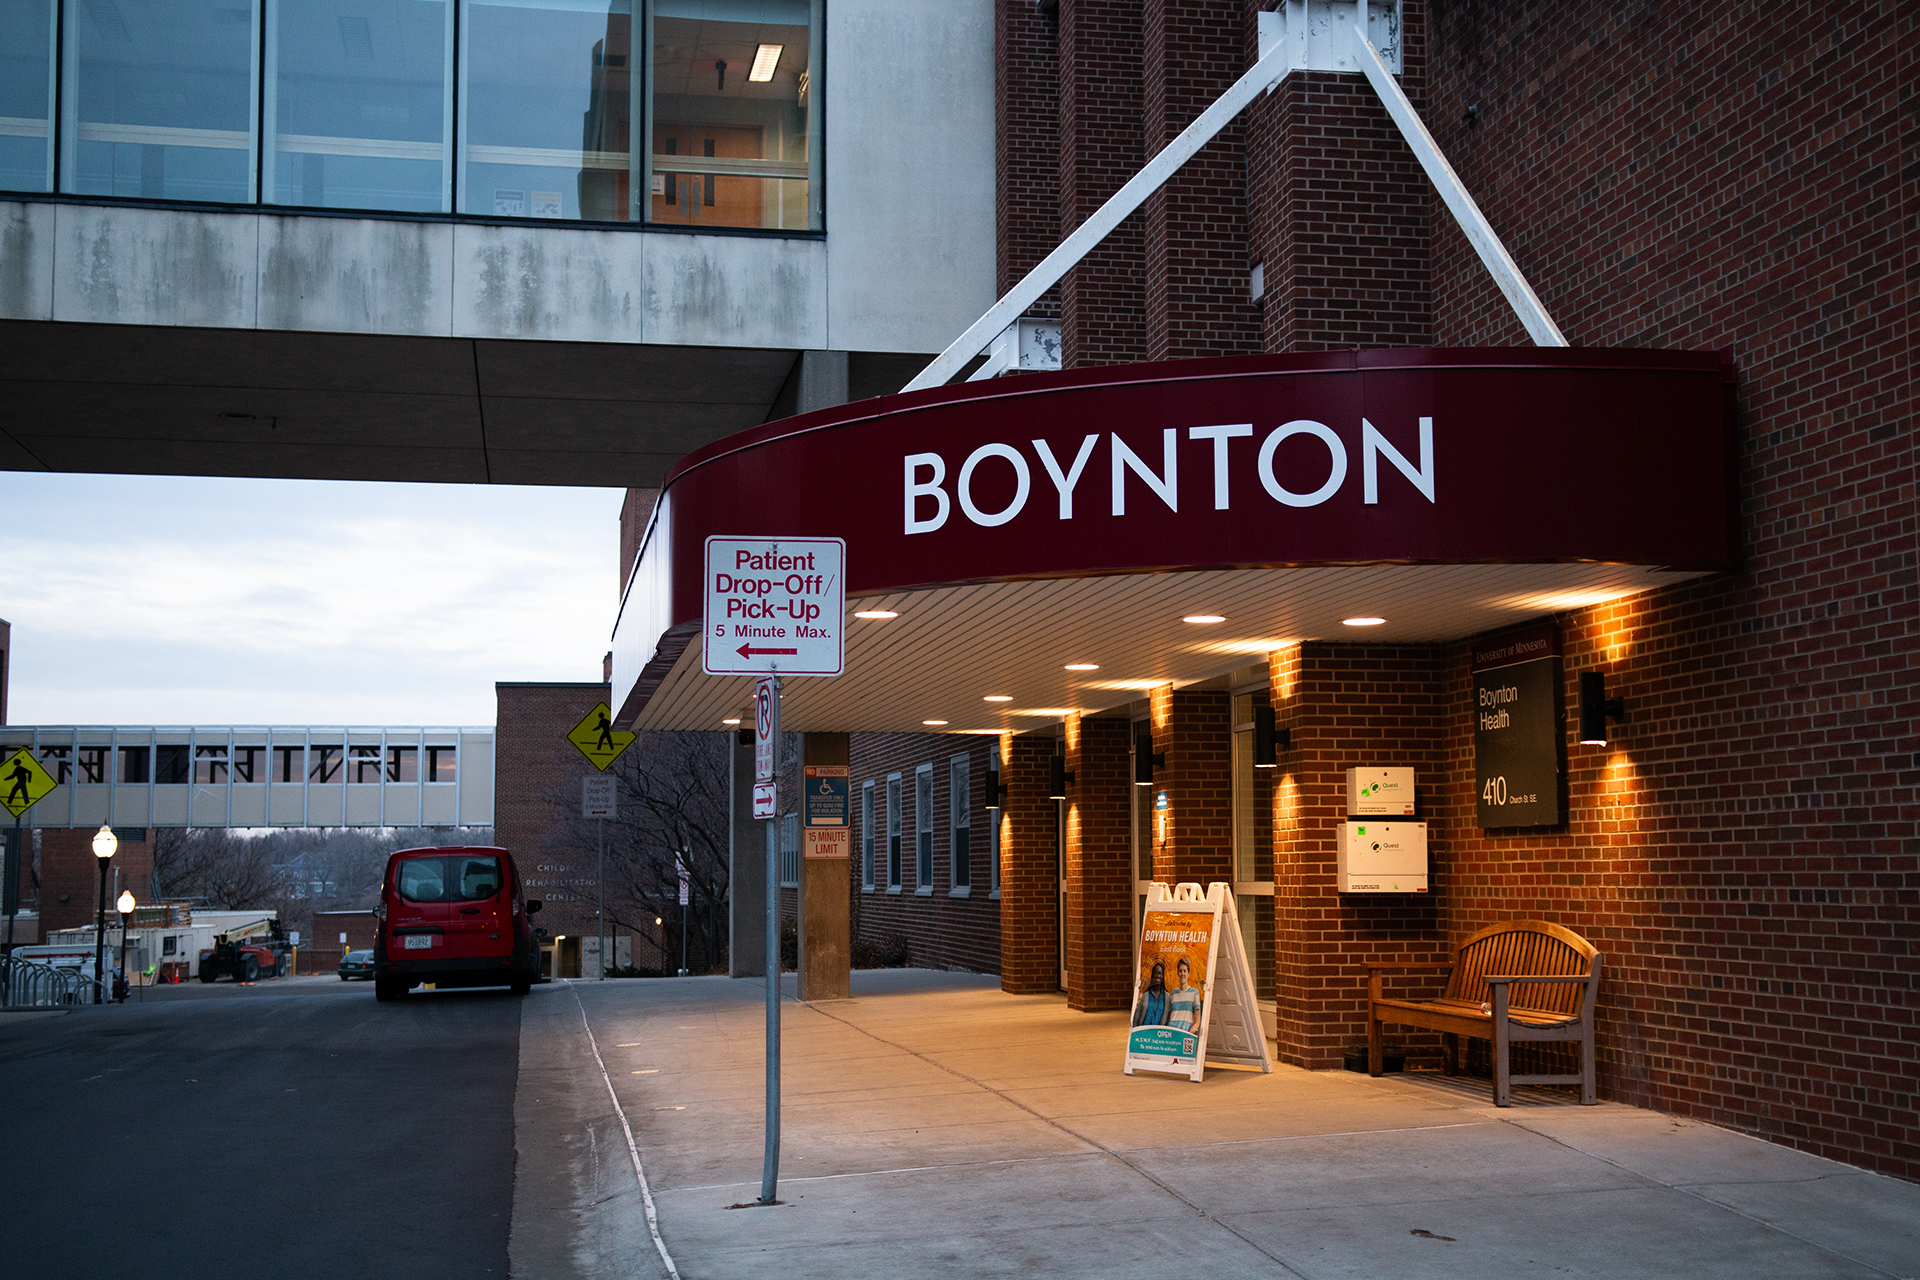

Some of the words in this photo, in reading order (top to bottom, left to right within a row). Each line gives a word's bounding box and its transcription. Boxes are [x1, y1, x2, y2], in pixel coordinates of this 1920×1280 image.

[904, 416, 1435, 535] BOYNTON
[736, 550, 815, 571] Patient
[716, 573, 835, 598] Drop-Off/
[726, 598, 820, 623] Pick-Up
[715, 624, 726, 637] 5
[735, 625, 786, 637] Minute
[795, 625, 831, 638] Max.
[1479, 685, 1518, 709] Boynton
[1480, 709, 1510, 731] Health
[806, 768, 816, 776] NO
[819, 768, 845, 776] PARKING
[1482, 775, 1507, 806] 410
[809, 832, 817, 842] 15
[818, 832, 846, 842] MINUTE
[815, 844, 838, 854] LIMIT
[1145, 929, 1178, 942] BOYNTON
[1178, 930, 1208, 943] HEALTH
[1160, 944, 1172, 953] East
[1172, 944, 1187, 953] Bank
[1157, 1030, 1172, 1038] OPEN
